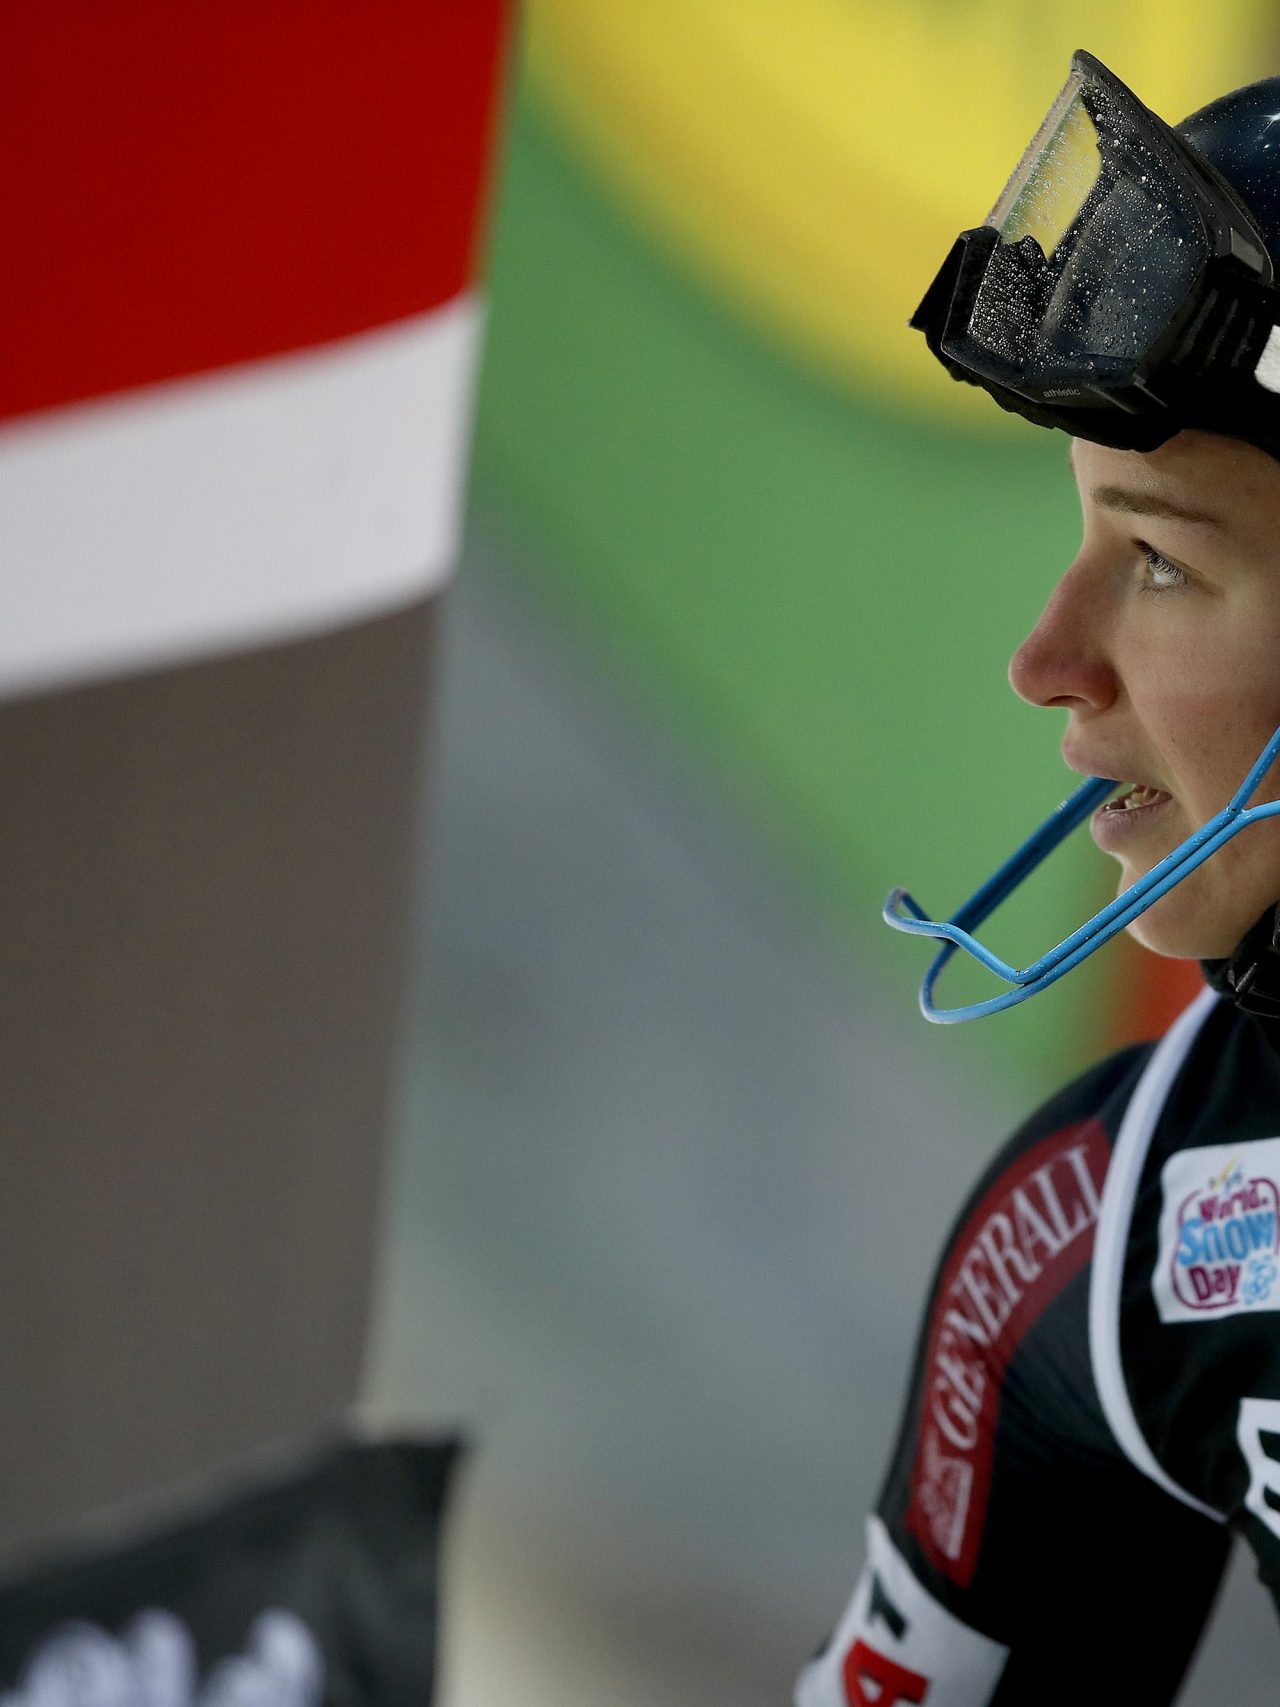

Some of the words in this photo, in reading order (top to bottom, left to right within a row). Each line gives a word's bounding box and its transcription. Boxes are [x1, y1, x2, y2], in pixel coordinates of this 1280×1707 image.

[1042, 387, 1081, 398] athletic
[1179, 1211, 1276, 1267] Snow
[930, 1143, 1102, 1450] GENERALI
[1188, 1263, 1241, 1302] Day
